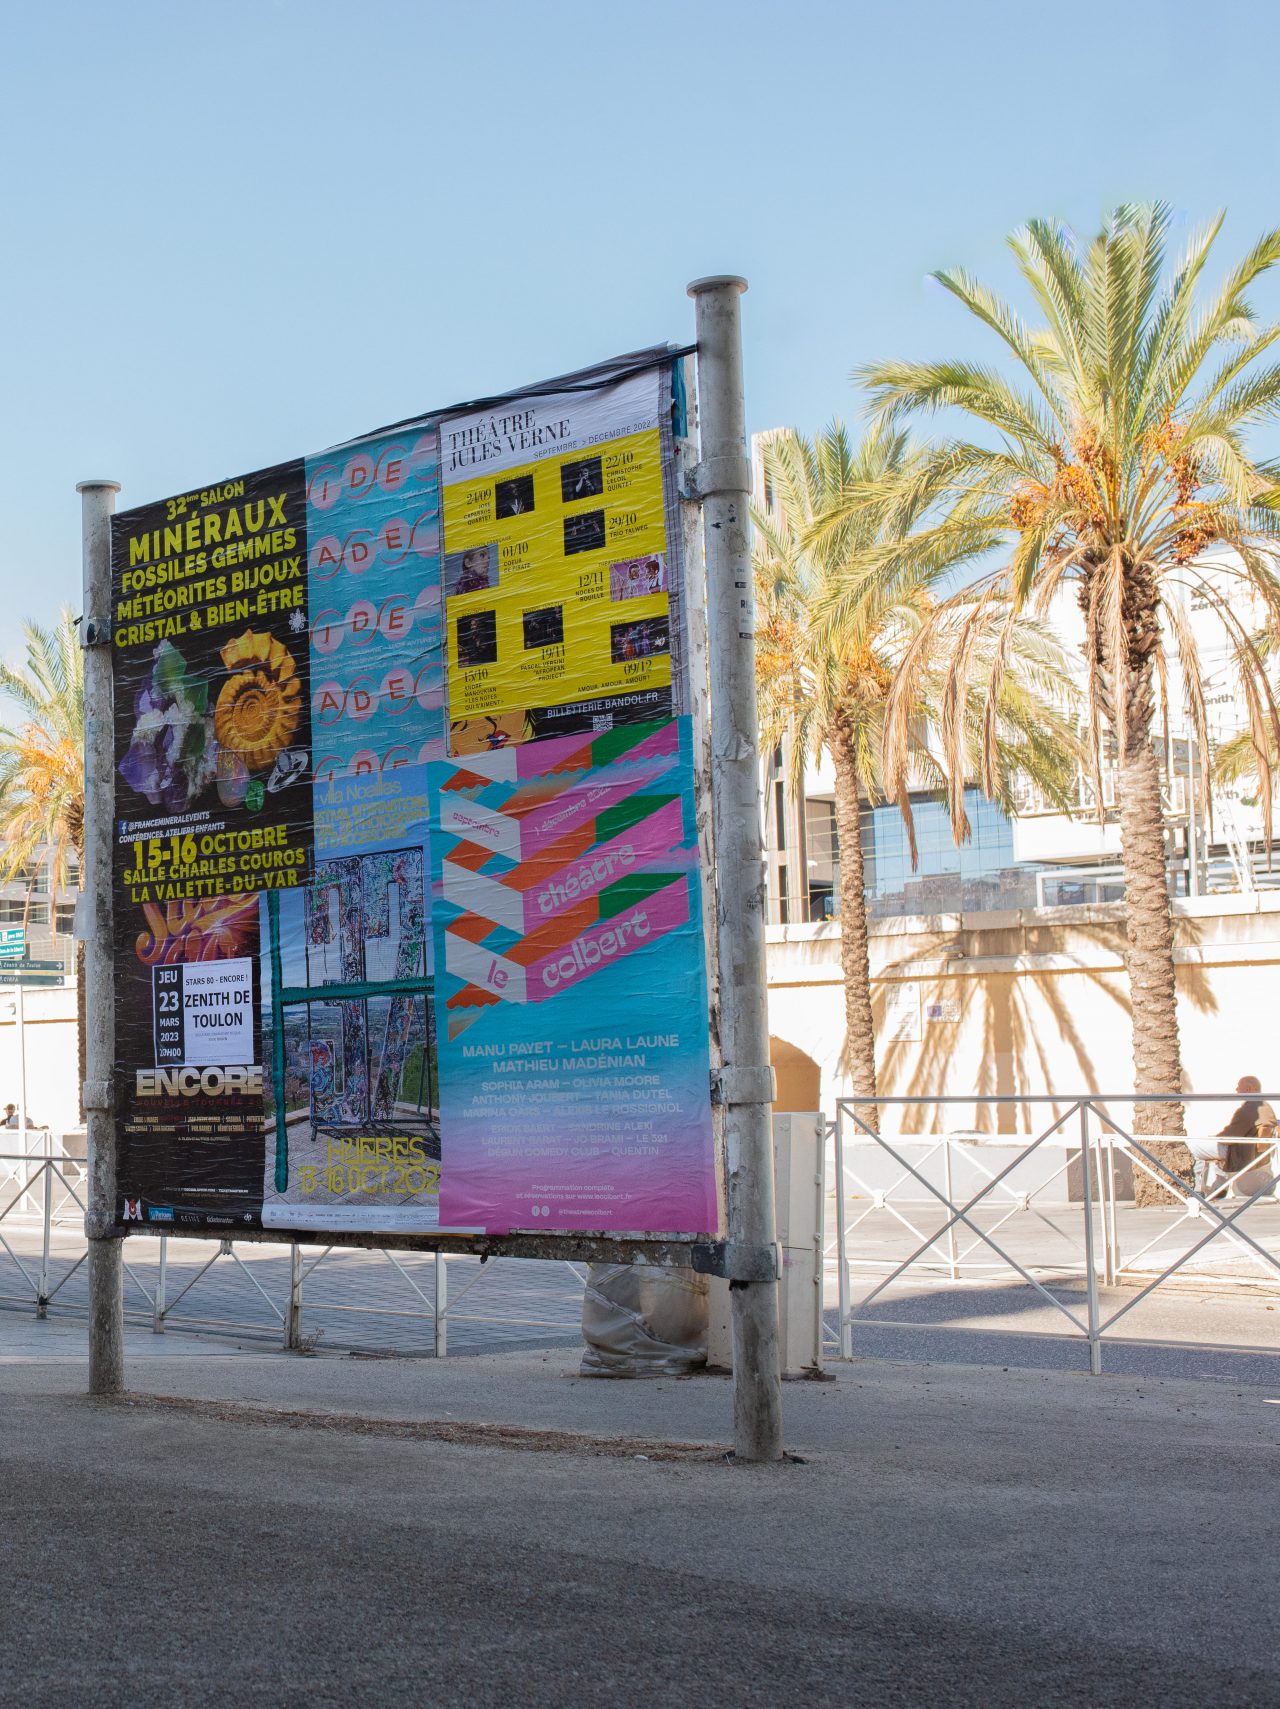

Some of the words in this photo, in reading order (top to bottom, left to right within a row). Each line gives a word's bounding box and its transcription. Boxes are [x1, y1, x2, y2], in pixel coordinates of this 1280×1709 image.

[449, 409, 536, 450] THÉÂTRE
[449, 440, 502, 471] JULES
[507, 419, 570, 452] VERNE
[533, 440, 578, 459] SEPTEMBRE
[633, 420, 651, 431] 2022
[606, 452, 634, 469] 22/10
[606, 464, 643, 477] CHRISTOPHE
[200, 481, 244, 507] SALON
[607, 481, 632, 492] QUINTET
[129, 493, 288, 566] MINÉRAUX
[609, 513, 637, 530] 29/10
[609, 529, 623, 538] TRIO
[502, 542, 529, 558] 01/10
[121, 553, 207, 594] FOSSILES
[211, 528, 296, 569] GEMMES
[579, 571, 604, 588] 12/11
[118, 576, 227, 621] MÉTÉORITES
[231, 556, 301, 594] BIJOUX
[575, 587, 595, 596] NOCES
[115, 615, 186, 648] CRISTAL
[190, 611, 203, 629] &
[207, 585, 304, 627] BIEN-ÊTRE
[541, 645, 566, 660] 19/11
[623, 660, 652, 675] 09/12
[547, 692, 658, 718] BILLETTERIE.BANDOL.FR
[128, 811, 210, 832] @FRANCEMINERALEVENTS
[195, 822, 225, 833] ENFANTS
[133, 834, 198, 870] 15-16
[200, 824, 288, 855] OCTOBRE
[123, 867, 166, 885] SALLE
[169, 857, 236, 879] CHARLES
[240, 848, 306, 871] COUROS
[132, 886, 150, 903] LA
[156, 870, 298, 900] VALETTE-DU-VAR
[487, 959, 509, 989] le
[542, 911, 651, 988] colbert
[158, 970, 178, 984] JEU
[186, 978, 205, 986] STARS
[206, 976, 214, 984] 80
[220, 975, 244, 983] ENCORE
[159, 991, 179, 1011] 23
[185, 992, 230, 1008] ZENITH
[234, 990, 250, 1005] DE
[160, 1017, 180, 1027] MARS
[193, 1012, 242, 1028] TOULON
[160, 1032, 179, 1042] 2023
[463, 1043, 506, 1057] MANU
[509, 1041, 554, 1055] PAYET
[571, 1038, 622, 1052] LAURA
[627, 1034, 680, 1049] LAUNE
[493, 1058, 559, 1073] MATHIEU
[562, 1053, 646, 1070] MADÉNIAN
[136, 1066, 263, 1097] ENCORE
[481, 1080, 524, 1091] SOPHIA
[526, 1079, 560, 1089] ARAM
[614, 1075, 660, 1086] MOORE
[472, 1094, 526, 1105] ANTHONY
[633, 1089, 672, 1100] DUTEL
[613, 1102, 684, 1114] ROSSIGNOL
[612, 1146, 658, 1155] QUENTIN
